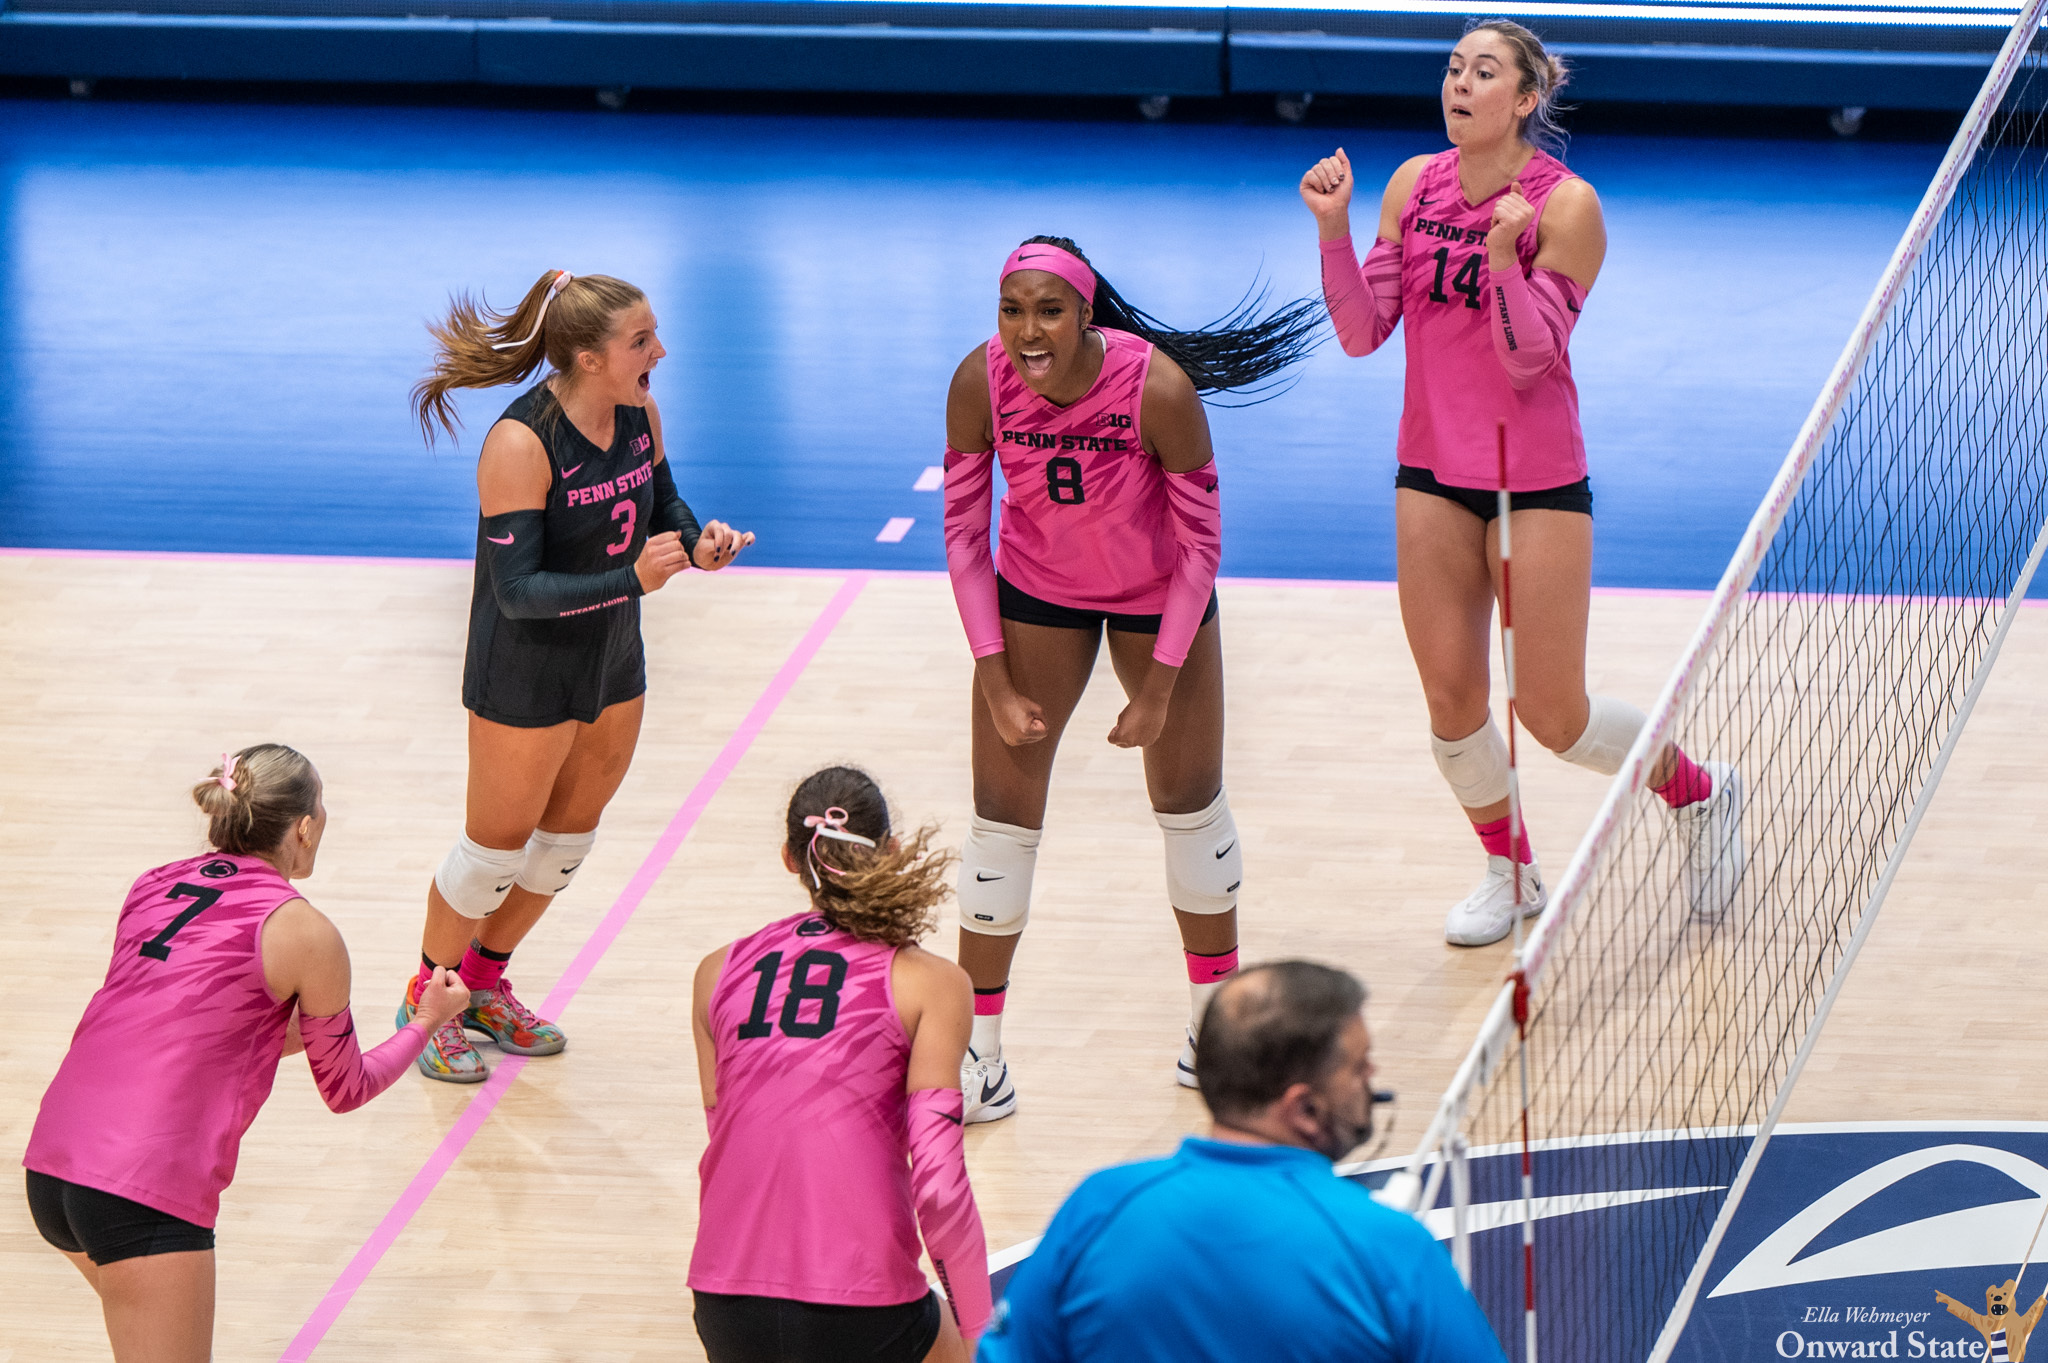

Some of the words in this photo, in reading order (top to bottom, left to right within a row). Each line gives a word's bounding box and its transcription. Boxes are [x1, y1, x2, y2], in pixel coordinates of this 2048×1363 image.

[1414, 218, 1464, 242] PENN
[1429, 246, 1483, 310] 14
[1495, 286, 1511, 324] NITTANY
[1503, 326, 1518, 351] LIONS
[1002, 430, 1056, 449] PENN
[1061, 435, 1127, 452] STATE
[567, 480, 615, 507] PENN
[616, 460, 652, 494] STATE
[1046, 457, 1085, 505] 8
[606, 499, 636, 556] 3
[560, 603, 601, 617] NITTANY
[138, 882, 224, 962] 7
[738, 949, 848, 1040] 18
